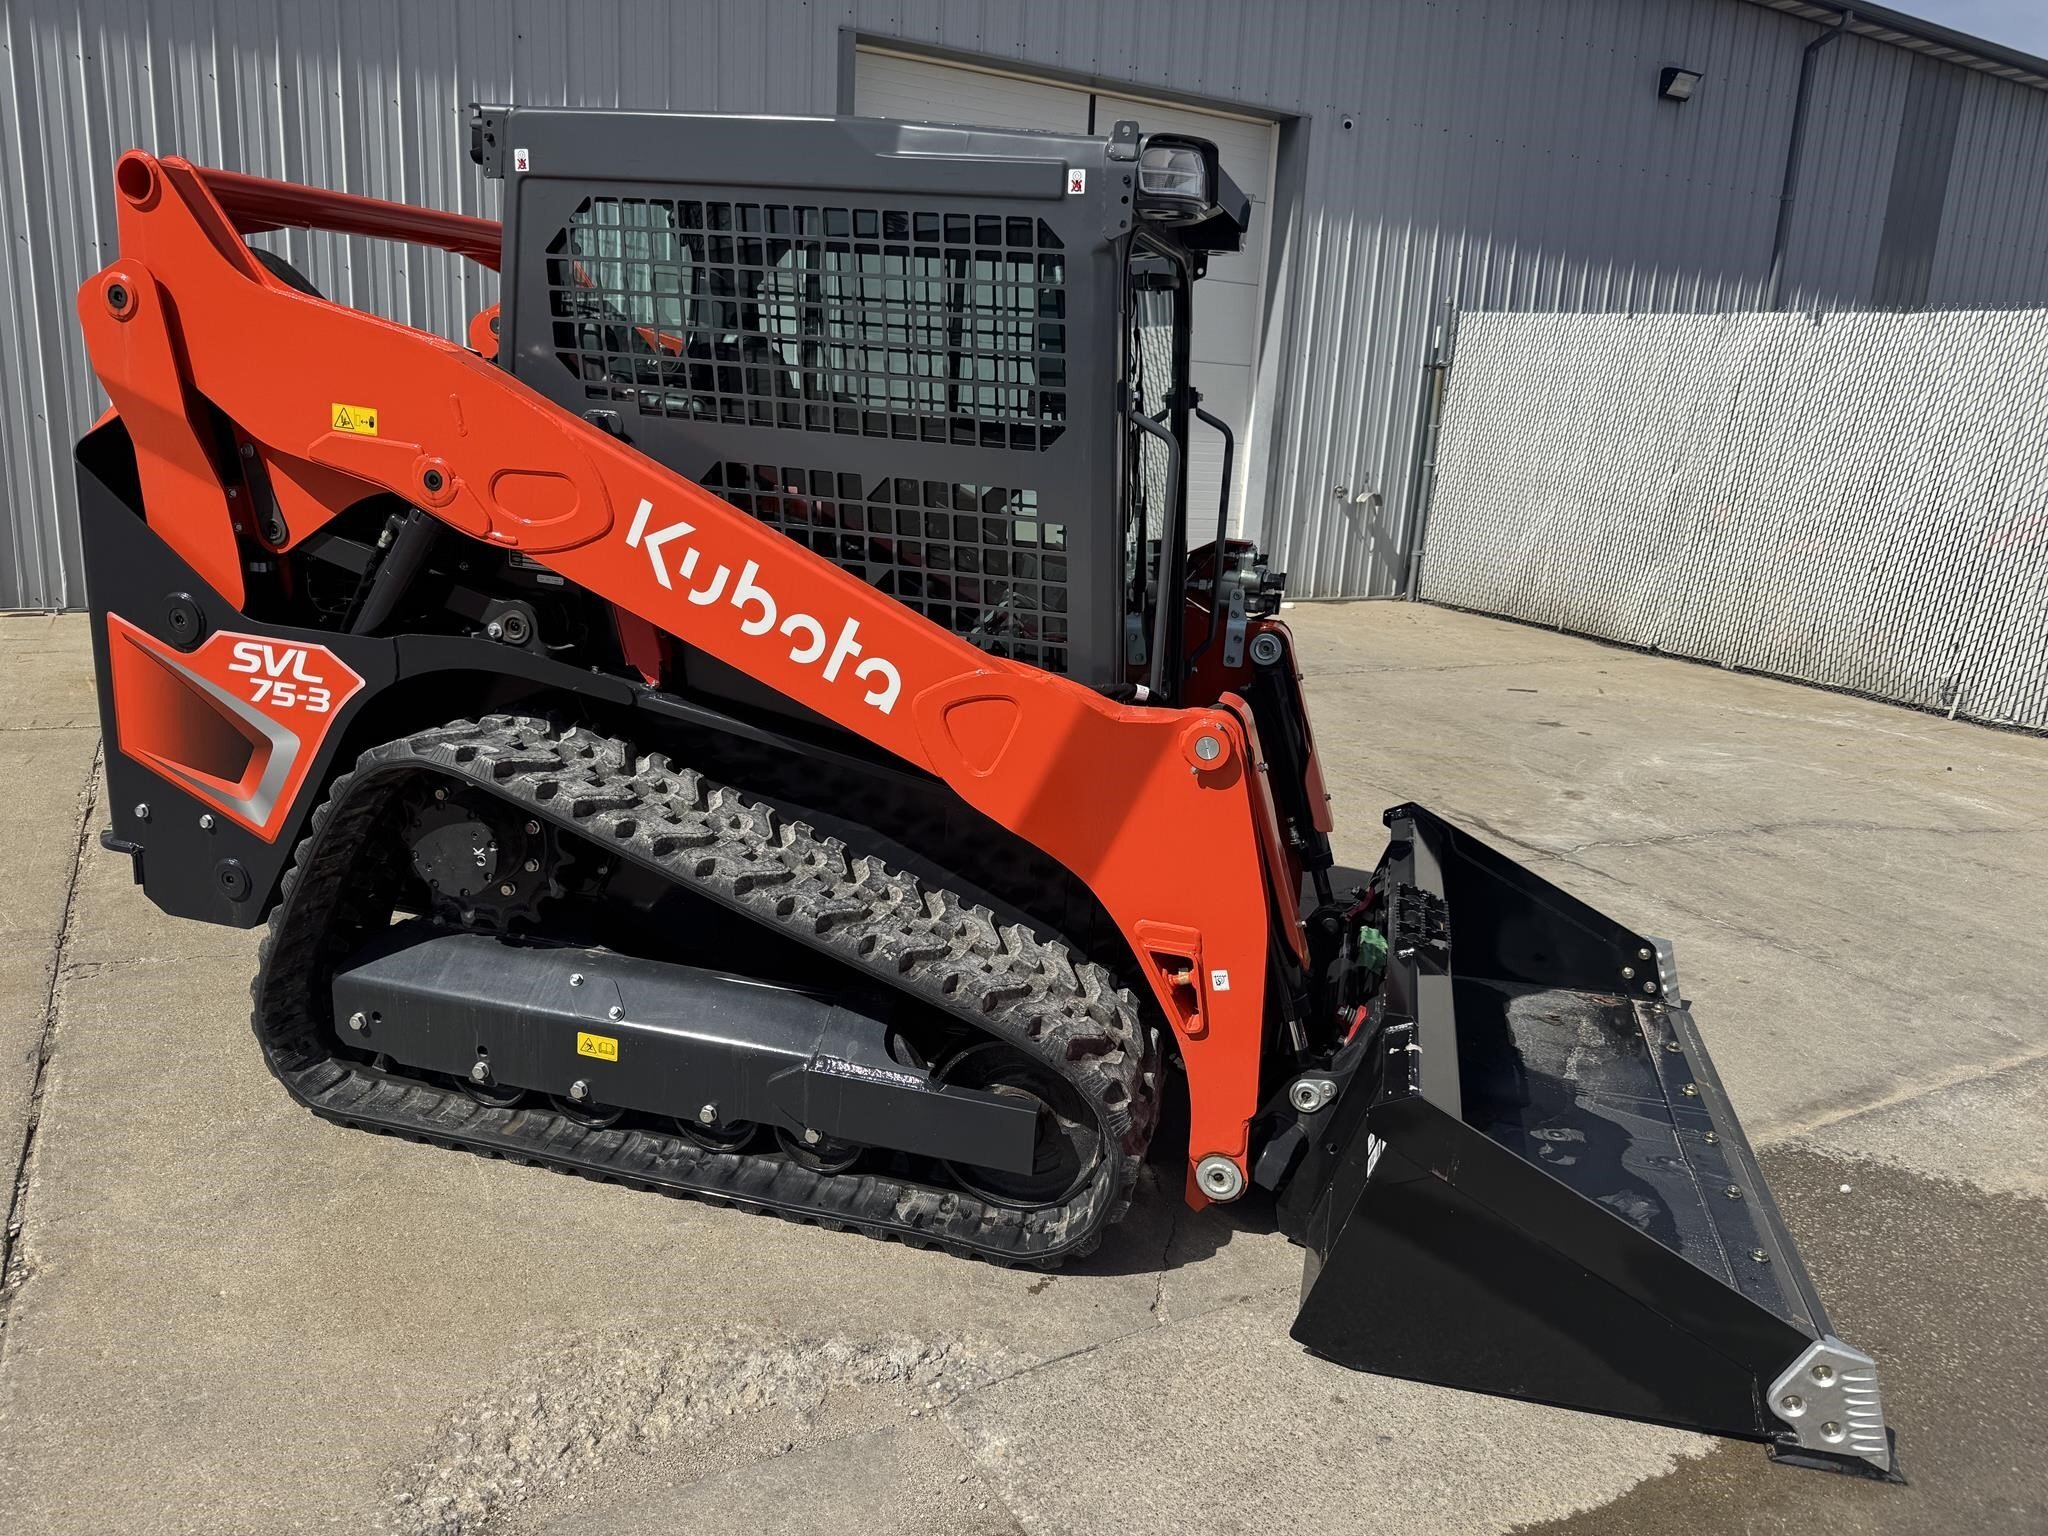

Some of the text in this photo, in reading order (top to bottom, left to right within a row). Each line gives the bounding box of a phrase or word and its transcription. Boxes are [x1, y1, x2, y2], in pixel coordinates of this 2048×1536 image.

[625, 498, 901, 715] Kubota
[228, 641, 324, 684] SVL
[249, 677, 331, 713] 75-3
